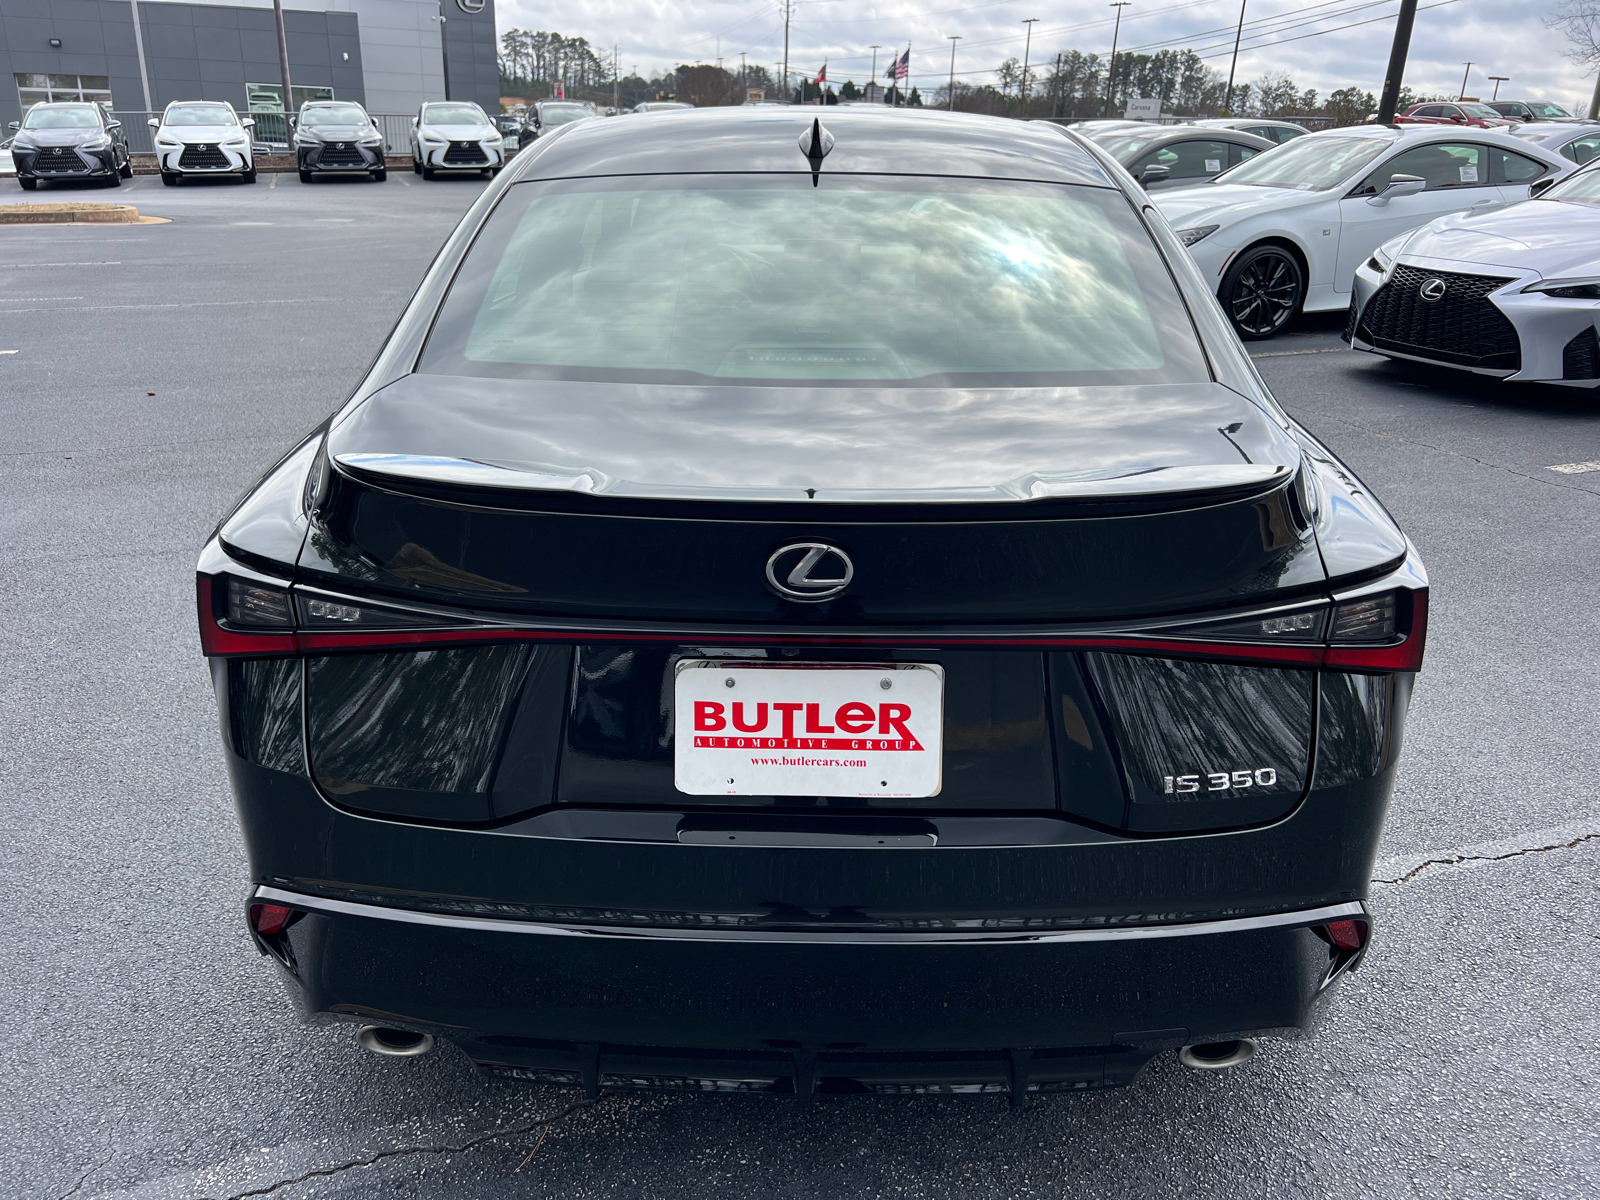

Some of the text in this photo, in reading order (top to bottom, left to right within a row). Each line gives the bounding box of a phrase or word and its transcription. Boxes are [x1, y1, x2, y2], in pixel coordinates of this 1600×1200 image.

[695, 737, 917, 750] AUTOMOTIVE GROUP
[751, 756, 868, 768] www.butlercars.com
[1163, 767, 1277, 795] IS 350
